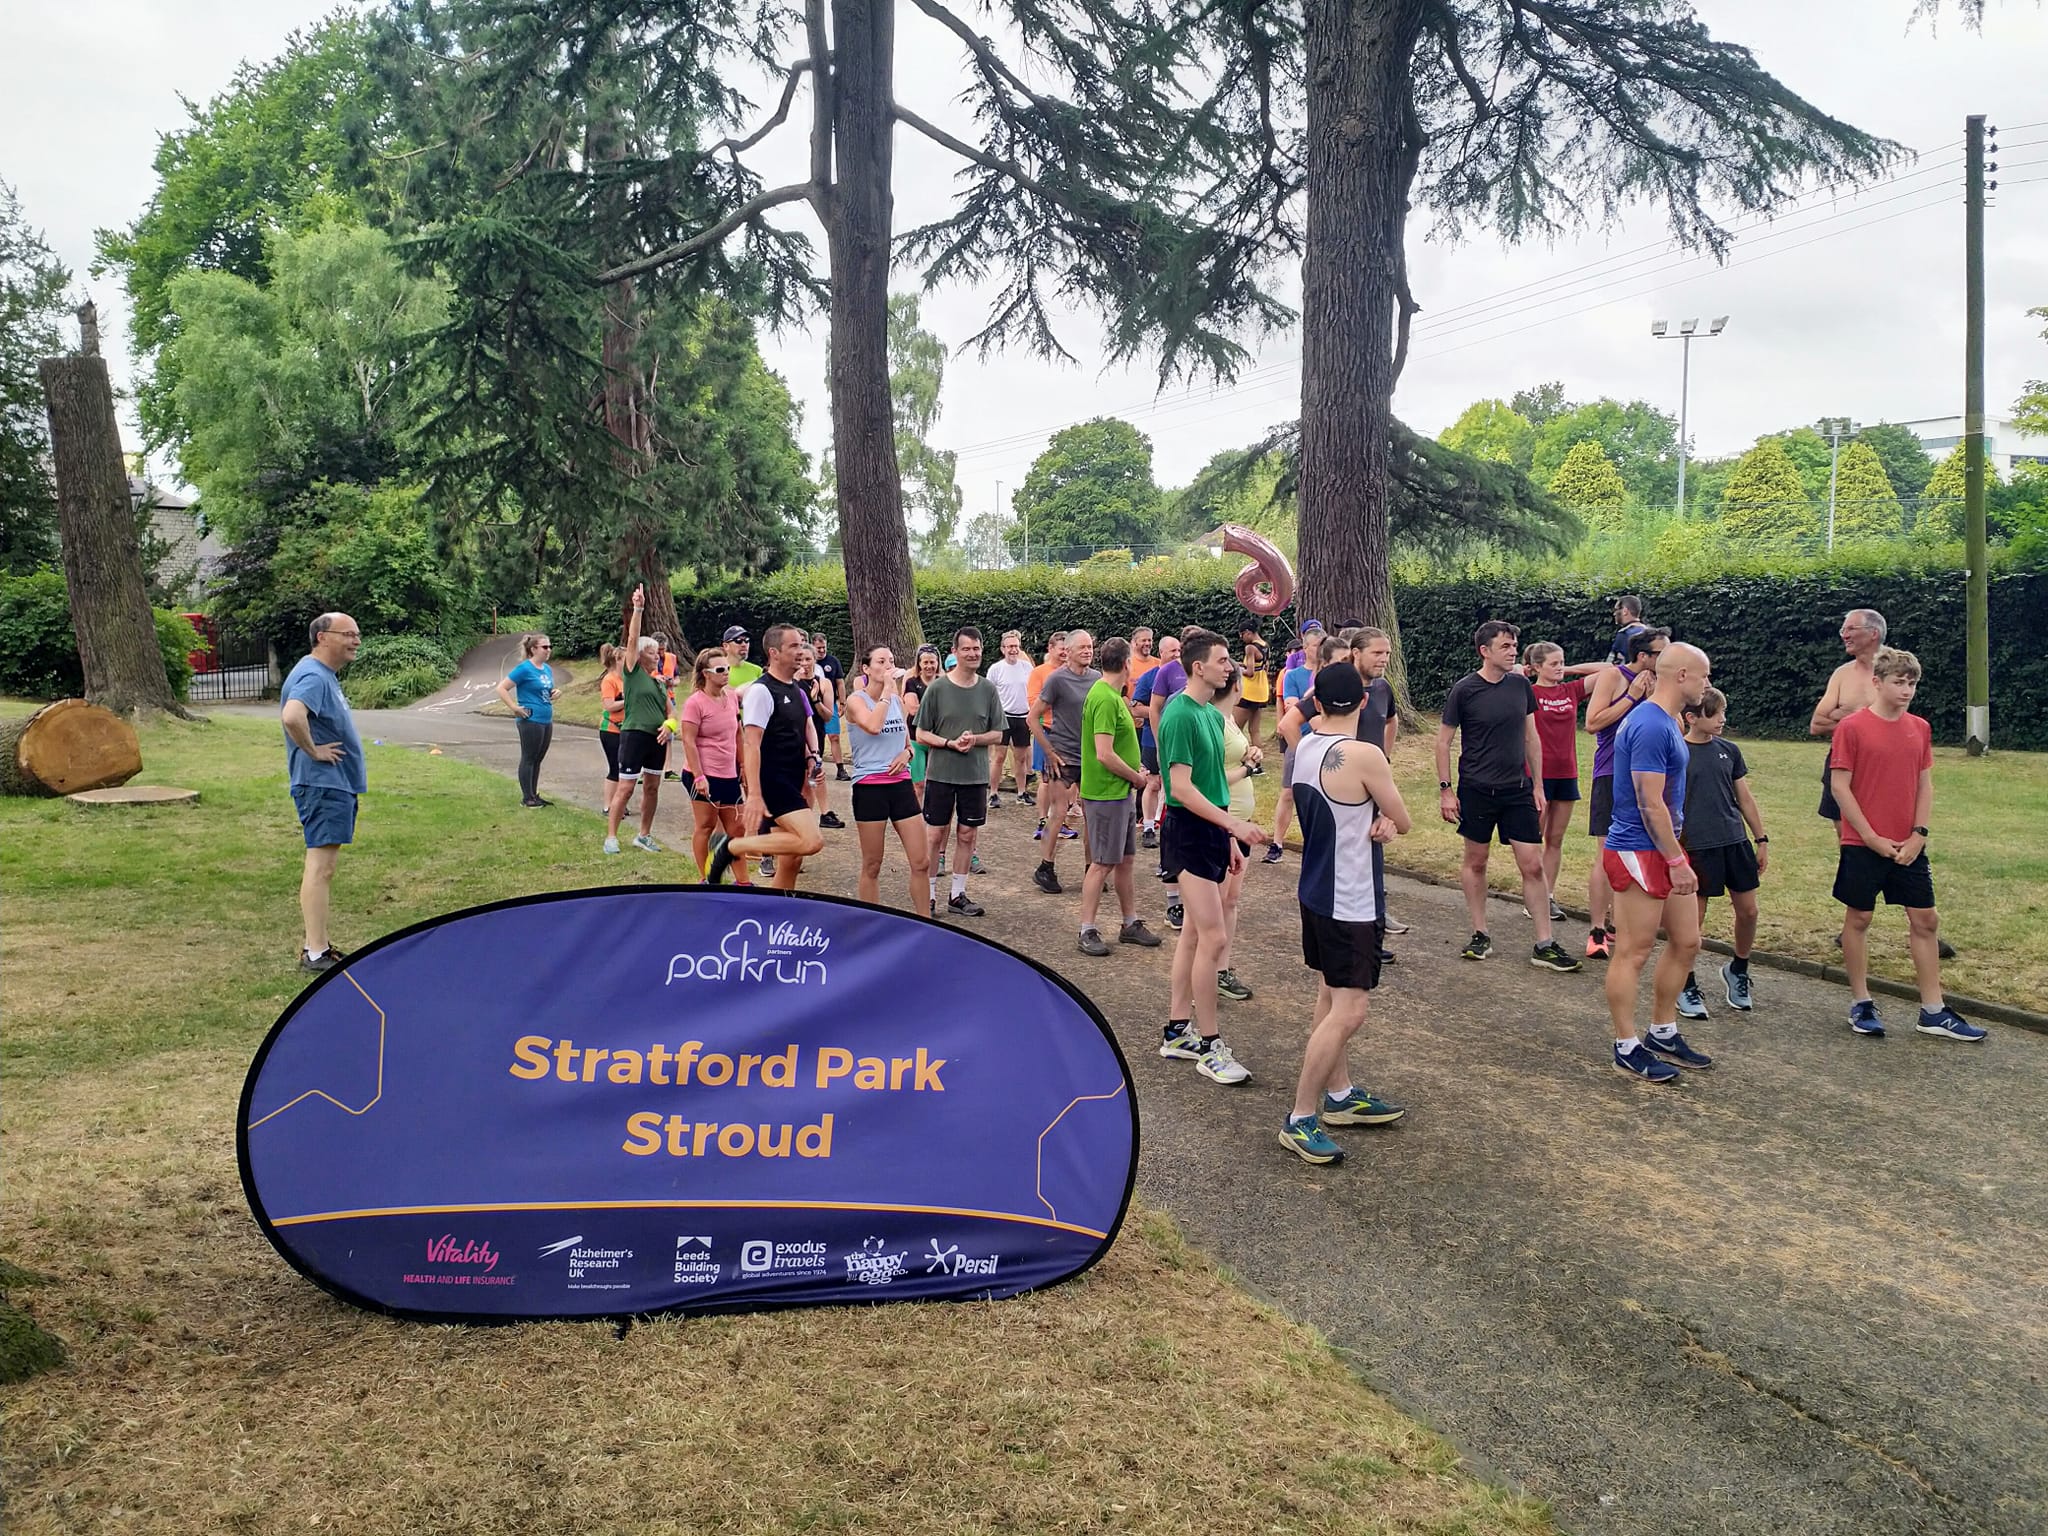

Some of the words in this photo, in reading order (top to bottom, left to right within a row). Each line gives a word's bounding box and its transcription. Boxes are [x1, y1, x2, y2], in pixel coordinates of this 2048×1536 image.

[769, 920, 830, 956] Vitality
[665, 940, 827, 986] parkrun
[508, 1034, 800, 1088] Stratford
[815, 1046, 947, 1091] Park
[622, 1111, 835, 1158] Stroud
[427, 1233, 500, 1274] Vitality
[570, 1248, 634, 1259] Alzheimer's
[775, 1240, 827, 1254] exodus
[676, 1250, 711, 1261] Leeds
[774, 1254, 825, 1268] travels
[844, 1251, 908, 1272] happy
[851, 1251, 866, 1260] the
[569, 1258, 619, 1268] Research
[674, 1261, 721, 1274] Building
[953, 1254, 999, 1277] Persil
[403, 1274, 435, 1284] HEALTH
[436, 1275, 454, 1284] AND
[455, 1275, 472, 1285] LIFE
[473, 1276, 516, 1286] INSURANCE
[568, 1268, 585, 1278] UK
[674, 1272, 718, 1284] Society
[742, 1272, 761, 1280] global
[859, 1268, 893, 1285] egg
